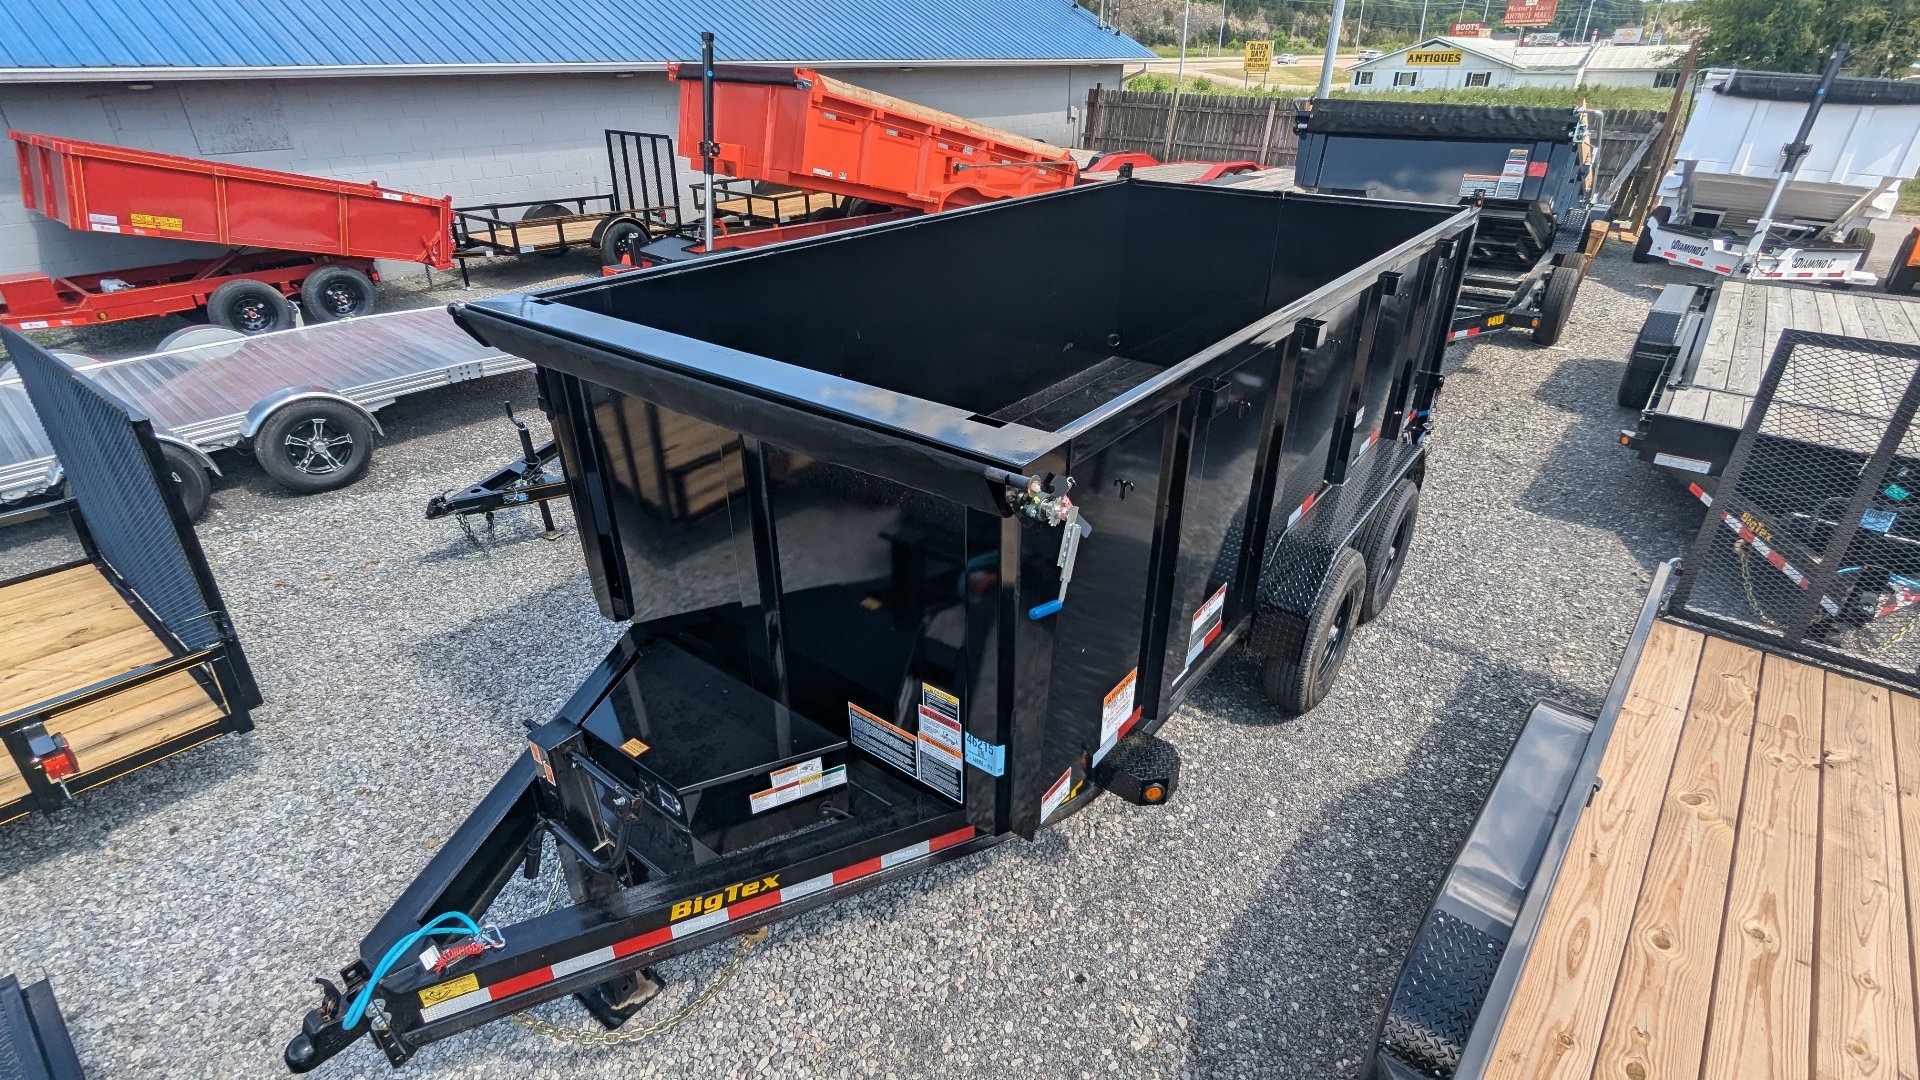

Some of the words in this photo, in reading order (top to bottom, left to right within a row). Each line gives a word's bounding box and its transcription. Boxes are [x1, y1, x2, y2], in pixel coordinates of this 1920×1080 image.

[1504, 12, 1532, 20] ANTIQUE
[1455, 23, 1480, 31] BOOTS
[1406, 53, 1462, 63] ANTIQUES
[1674, 240, 1701, 255] DIAMOND
[1701, 246, 1708, 257] C
[1795, 257, 1828, 268] DIAMOND
[1828, 258, 1836, 268] C
[966, 734, 994, 755] 46215
[670, 874, 781, 921] BigTex
